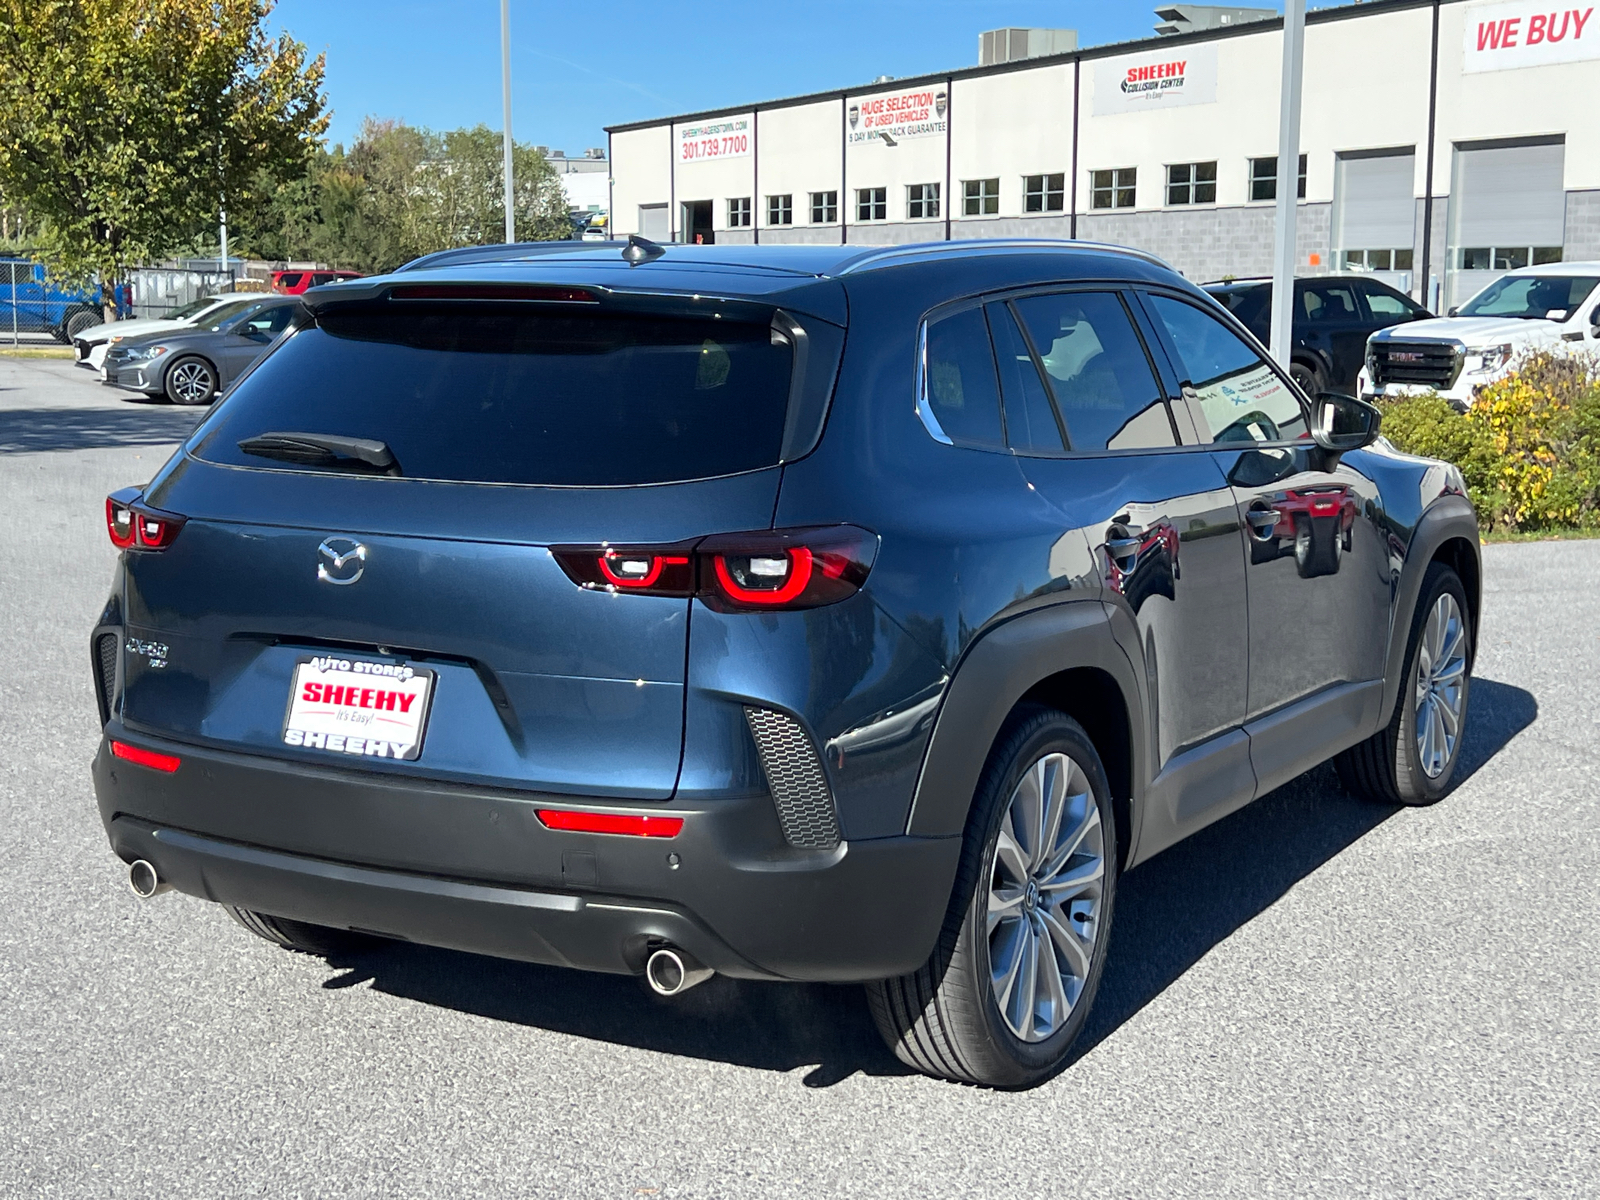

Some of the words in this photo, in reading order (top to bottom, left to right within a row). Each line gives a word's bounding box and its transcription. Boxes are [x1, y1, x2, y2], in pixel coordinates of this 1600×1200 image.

[1477, 18, 1521, 51] WE
[1526, 7, 1594, 45] BUY
[1127, 60, 1187, 82] SHEEHY
[1127, 81, 1159, 93] COLLISION
[1160, 78, 1185, 89] CENTER
[861, 99, 885, 115] HUGE
[885, 92, 933, 112] SELECTION
[864, 116, 874, 128] OF
[874, 113, 894, 127] USED
[895, 108, 929, 123] VEHICLES
[682, 121, 748, 139] SHEEHYHAGERSTOWN.COM
[849, 134, 853, 142] 5
[854, 132, 866, 141] DAY
[867, 129, 884, 140] MON
[907, 122, 946, 135] GUARANTEE
[682, 135, 747, 160] 301.739.7700
[310, 656, 351, 673] AUTO
[302, 682, 417, 713] SHEEHY
[336, 709, 348, 721] It's
[350, 711, 375, 726] Easy!
[284, 729, 414, 759] SHEEHY
